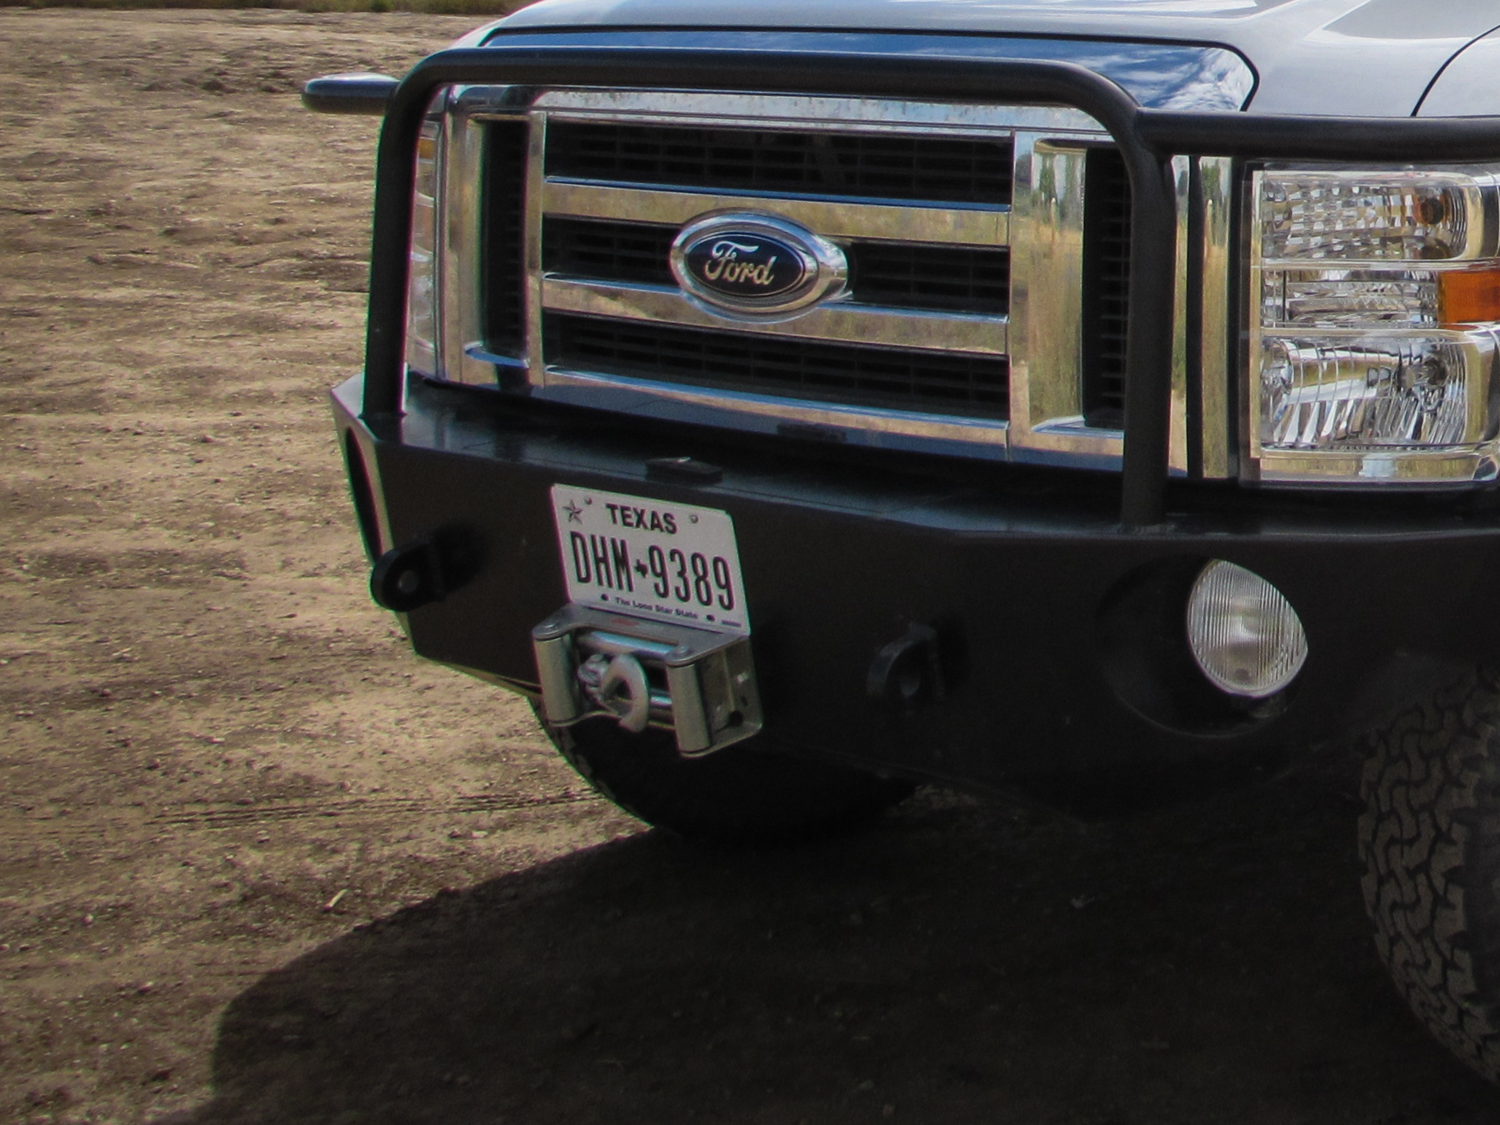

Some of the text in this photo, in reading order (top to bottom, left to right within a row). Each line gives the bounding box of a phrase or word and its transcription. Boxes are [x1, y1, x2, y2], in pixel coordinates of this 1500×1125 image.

[704, 240, 778, 286] Ford
[605, 503, 677, 535] TEXAS
[570, 530, 736, 612] DHM 9389
[615, 596, 698, 620] The Lone Star State
